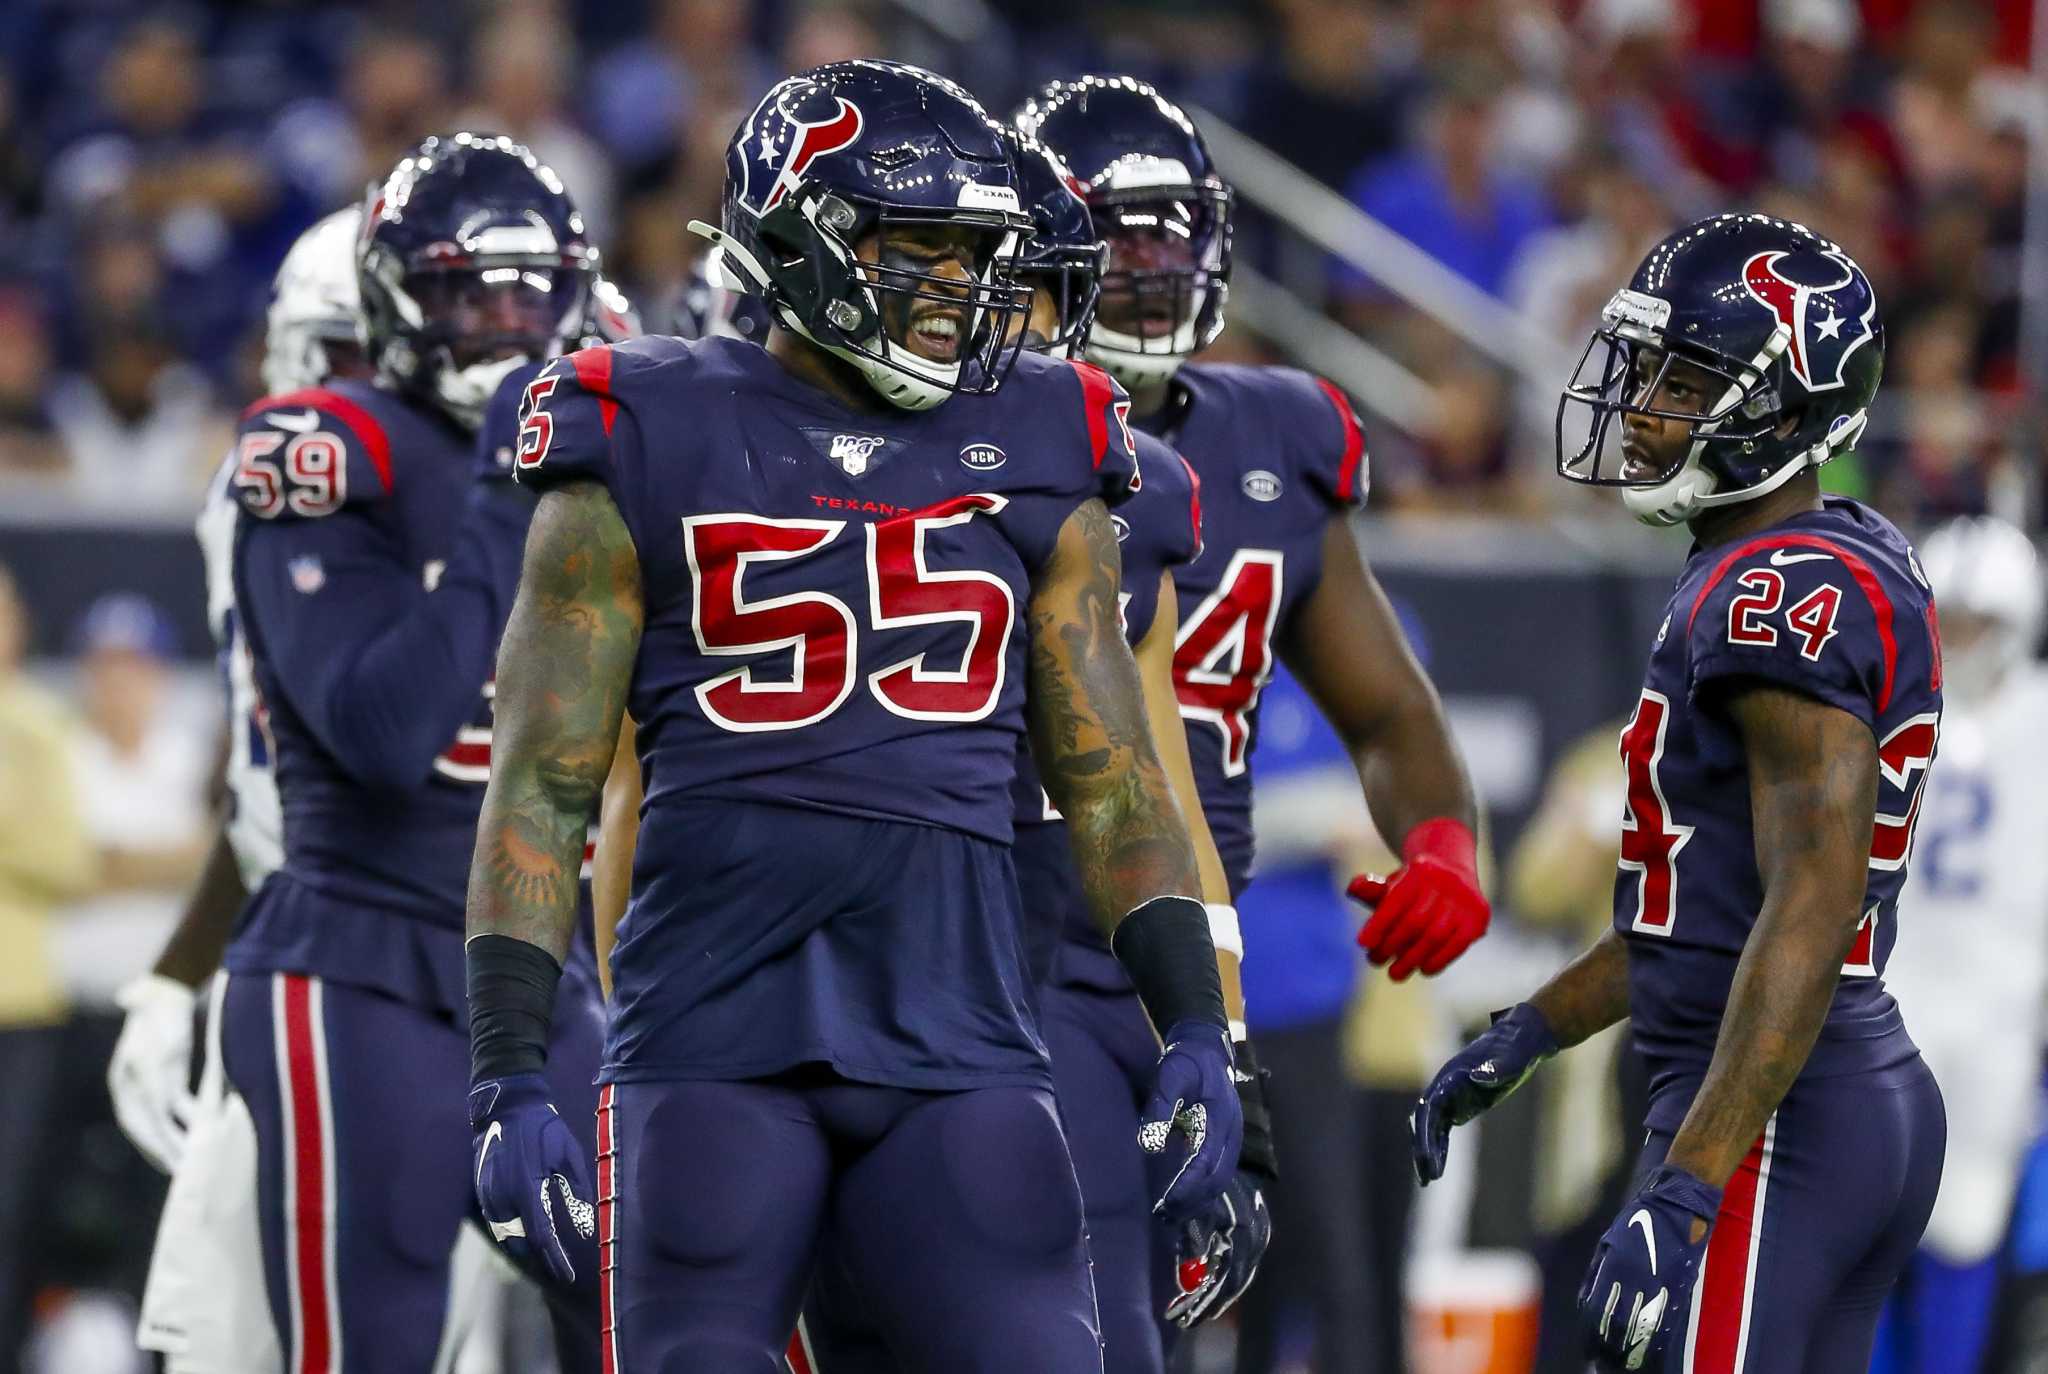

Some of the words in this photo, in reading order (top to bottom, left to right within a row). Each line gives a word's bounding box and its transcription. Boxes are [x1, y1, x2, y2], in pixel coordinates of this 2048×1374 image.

[233, 431, 347, 519] 59
[512, 375, 561, 483] 5
[682, 492, 1014, 732] 55
[1727, 567, 1843, 663] 24
